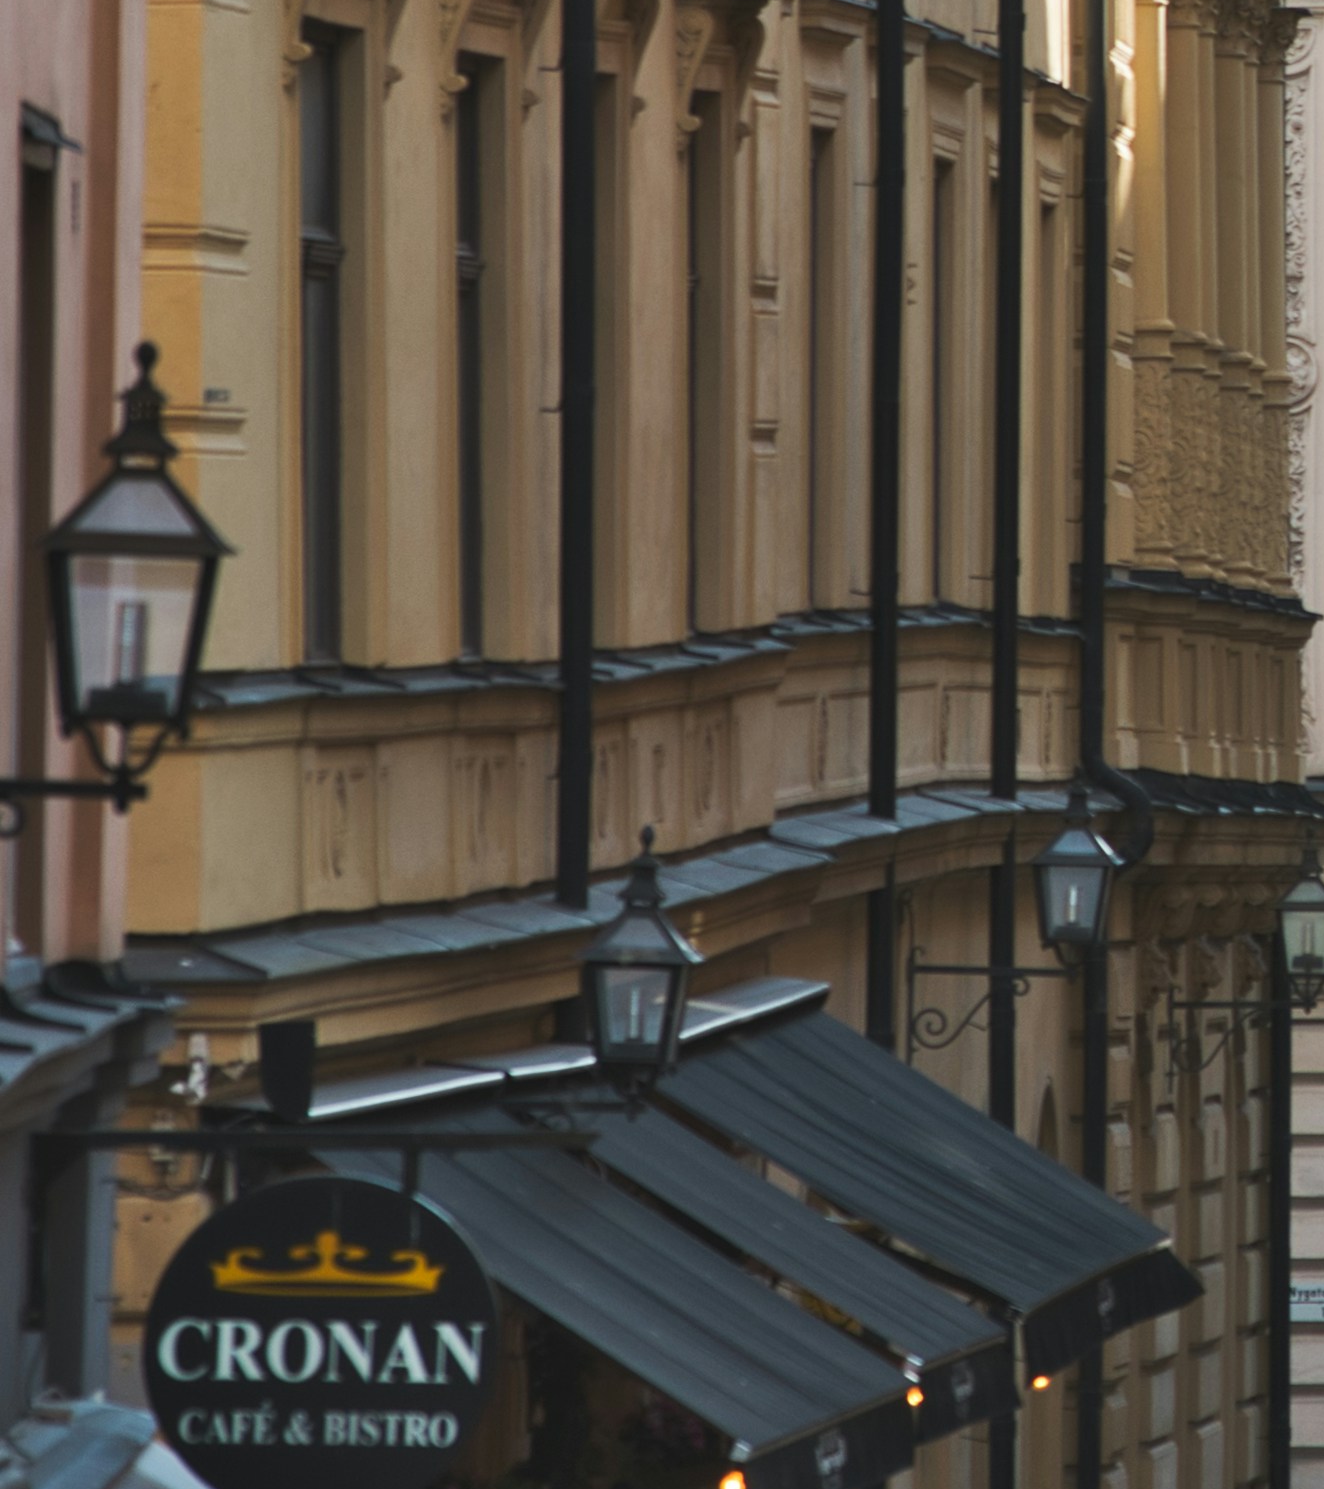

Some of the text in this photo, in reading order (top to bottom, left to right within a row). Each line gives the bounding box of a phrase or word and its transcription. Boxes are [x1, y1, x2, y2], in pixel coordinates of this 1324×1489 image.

[157, 1316, 484, 1385] CRONAN
[177, 1399, 459, 1448] CAFÉ & BISTRO
